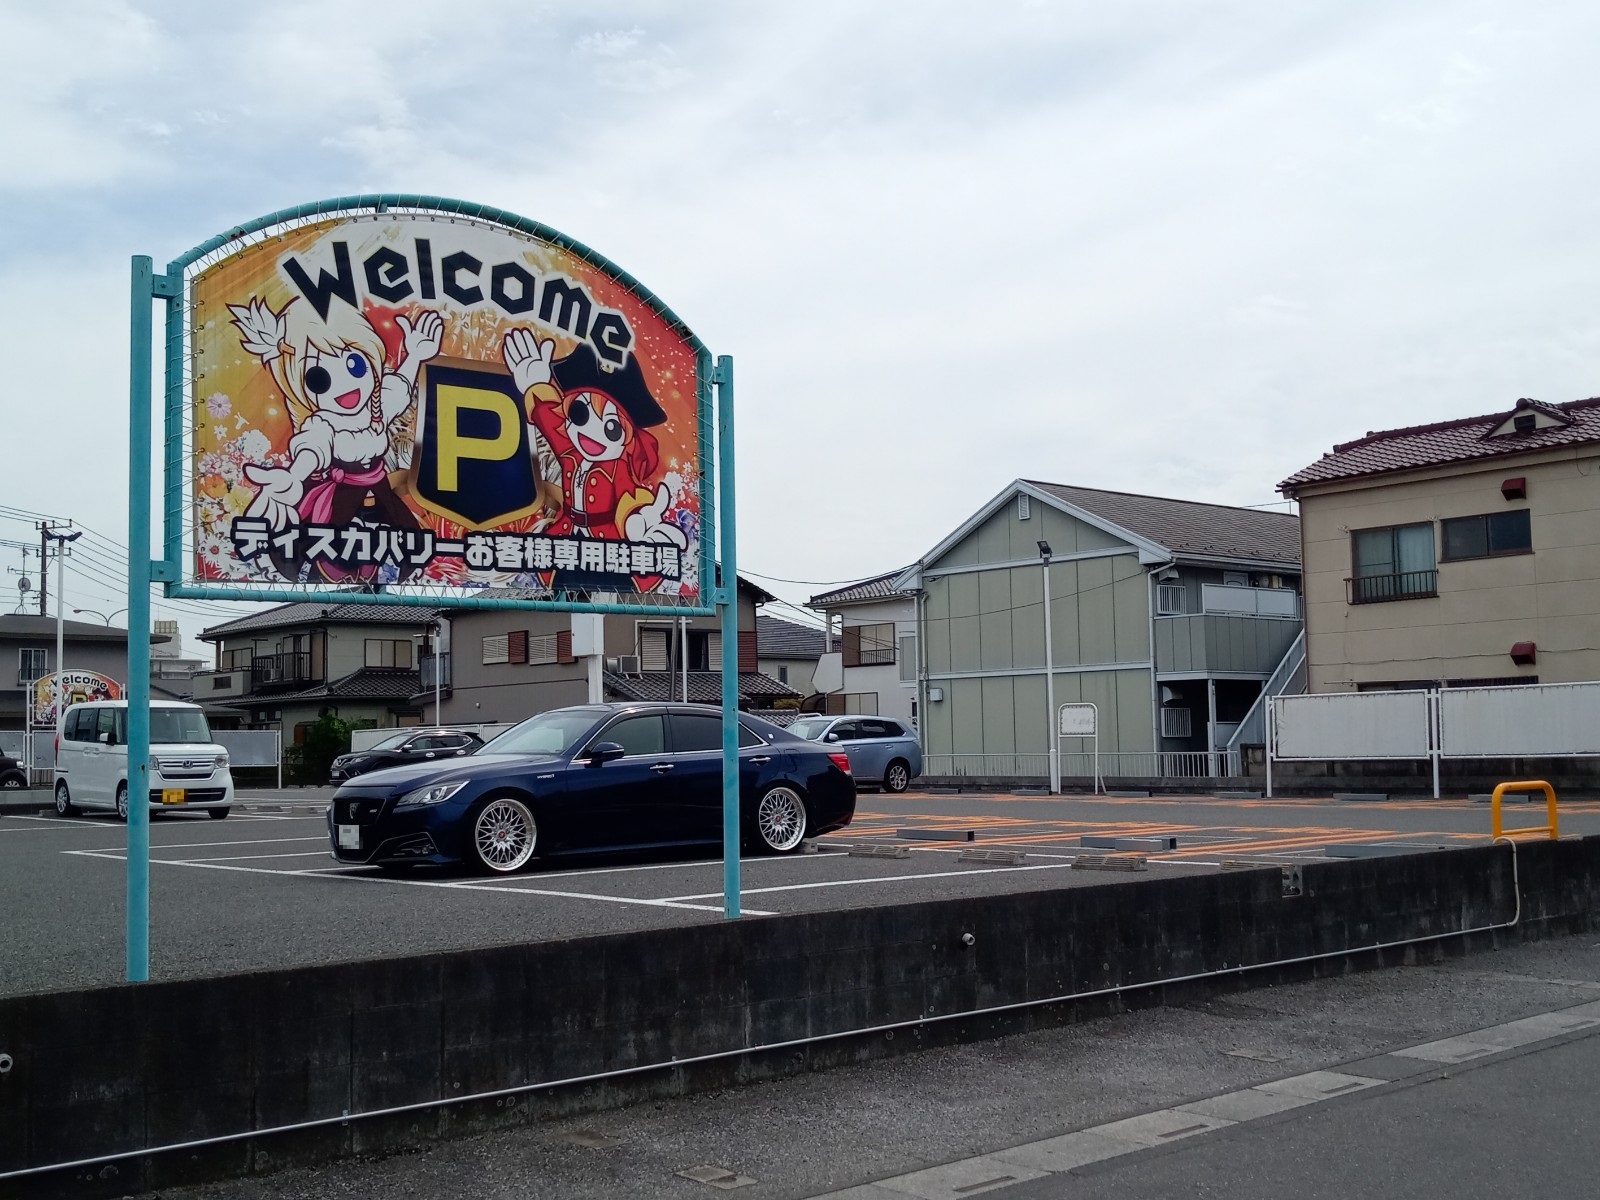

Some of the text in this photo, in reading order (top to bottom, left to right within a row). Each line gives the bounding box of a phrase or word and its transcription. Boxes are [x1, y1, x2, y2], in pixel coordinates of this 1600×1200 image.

[283, 238, 632, 362] Welcome
[436, 384, 521, 492] P
[235, 522, 679, 576] ディスカバリーお客様専用駐車場
